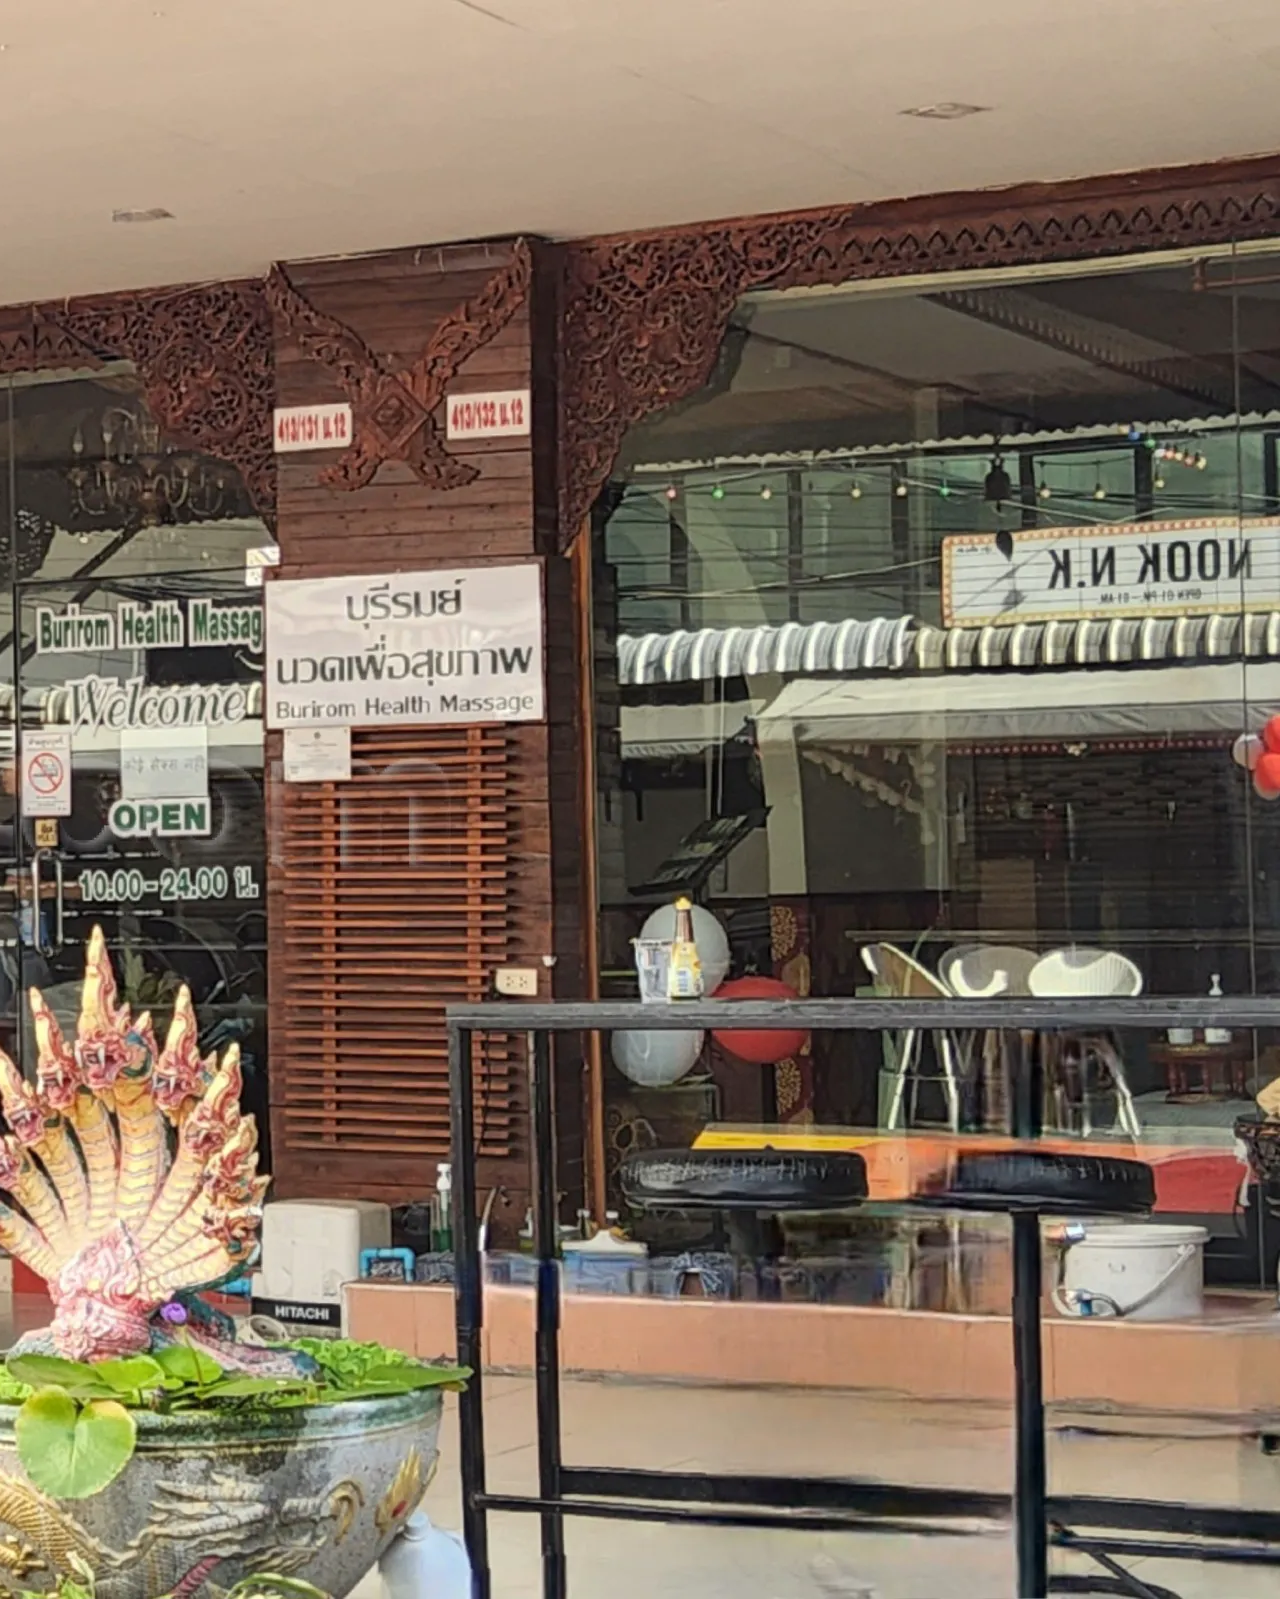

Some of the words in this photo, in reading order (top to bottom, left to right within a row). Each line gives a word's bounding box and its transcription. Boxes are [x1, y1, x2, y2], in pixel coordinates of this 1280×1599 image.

[40, 607, 110, 649] Burirom
[121, 604, 181, 645] Health
[192, 603, 262, 648] Massag
[346, 578, 466, 629] บุรีรมย์
[276, 635, 533, 686] นวดเพื่อสุขภาพ
[68, 676, 245, 737] Welcome
[276, 701, 356, 719] Burirom
[365, 696, 431, 716] Health
[440, 693, 534, 716] Massage
[113, 803, 207, 831] OPEN
[275, 1304, 330, 1321] HITACHI
